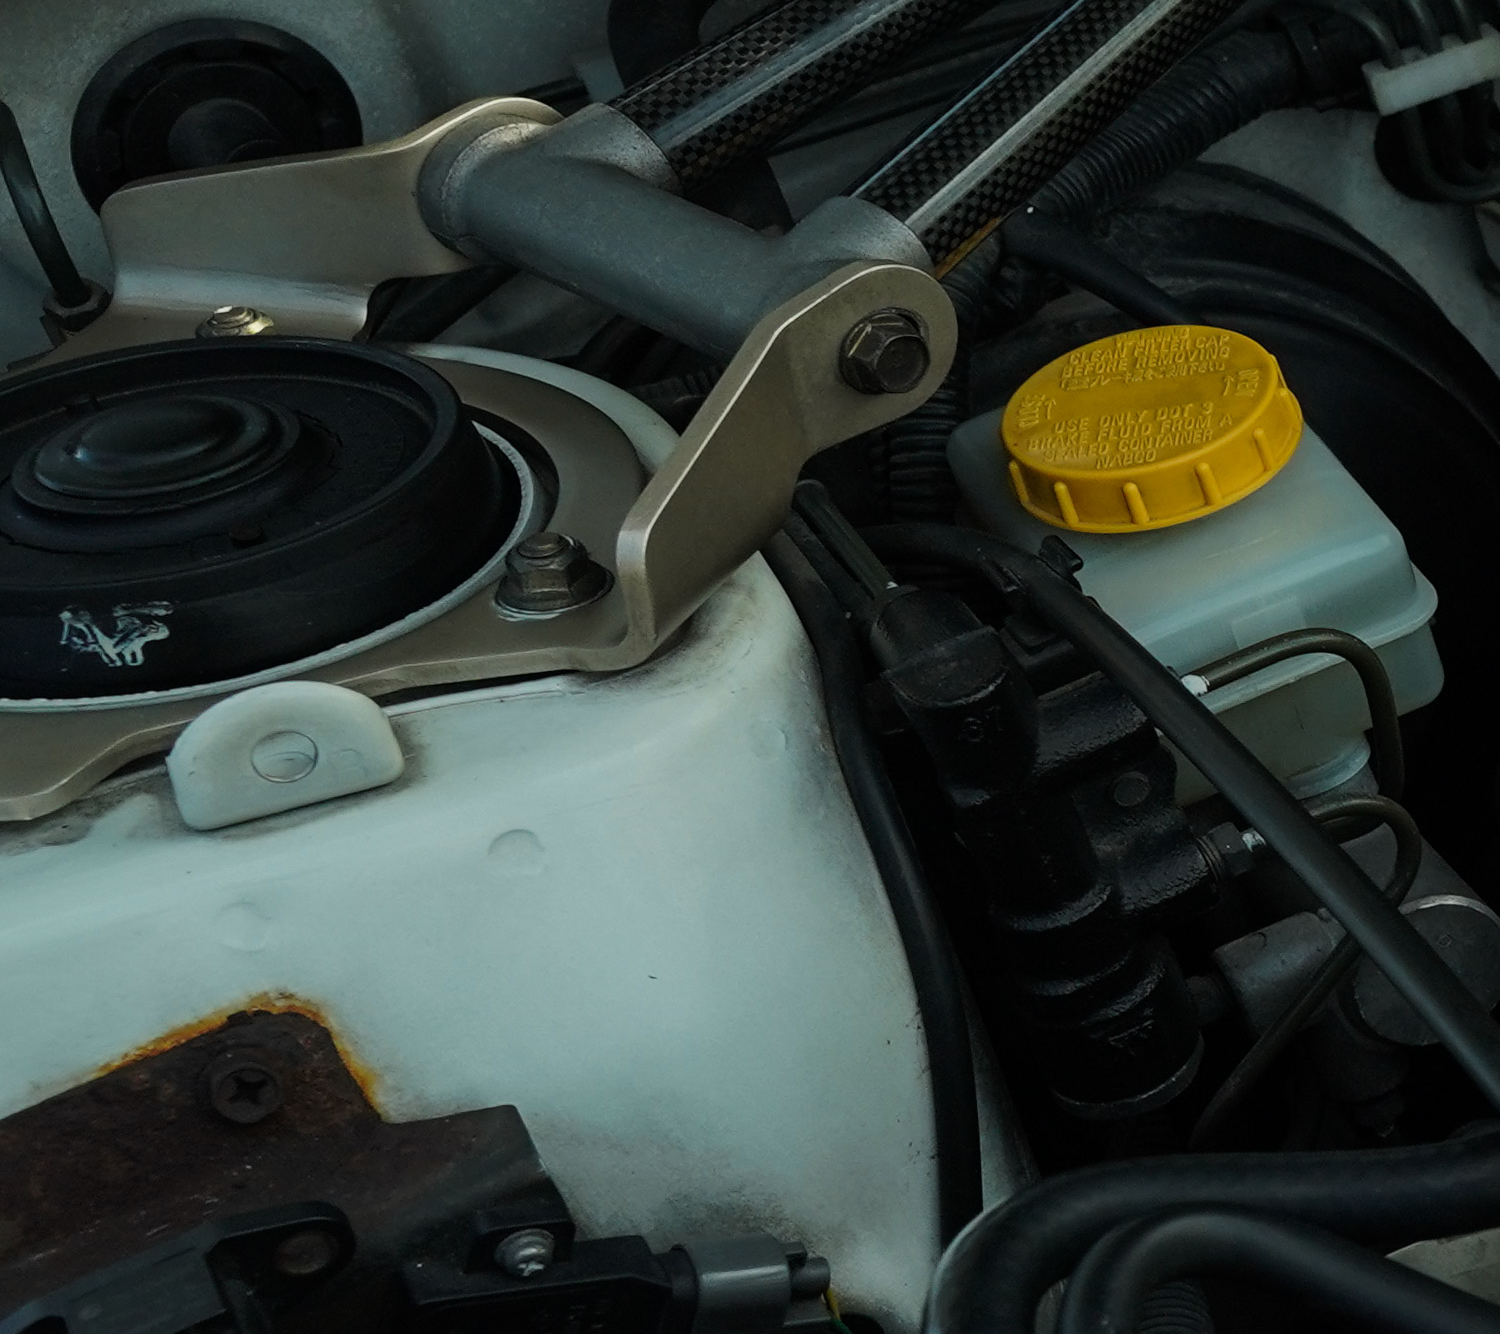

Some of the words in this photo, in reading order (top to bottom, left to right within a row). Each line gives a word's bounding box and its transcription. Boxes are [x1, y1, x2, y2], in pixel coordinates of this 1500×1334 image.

[1061, 359, 1128, 378] BEFORE
[1135, 348, 1230, 369] REMOVING
[1070, 342, 1126, 365] CLEAN
[1132, 338, 1191, 357] FILLER
[1194, 333, 1230, 350] CAP
[1028, 430, 1088, 450] BRAKE
[1097, 422, 1150, 443] FLUID
[1160, 413, 1213, 432] FROM
[1219, 413, 1232, 427] A
[1054, 417, 1088, 434] USE
[1099, 408, 1149, 427] ONLY
[1156, 403, 1193, 420] DOT
[1199, 401, 1213, 414] 3
[1041, 442, 1110, 462] SEALED
[1118, 428, 1213, 452] CONTAINER
[1094, 449, 1159, 470] NABCO
